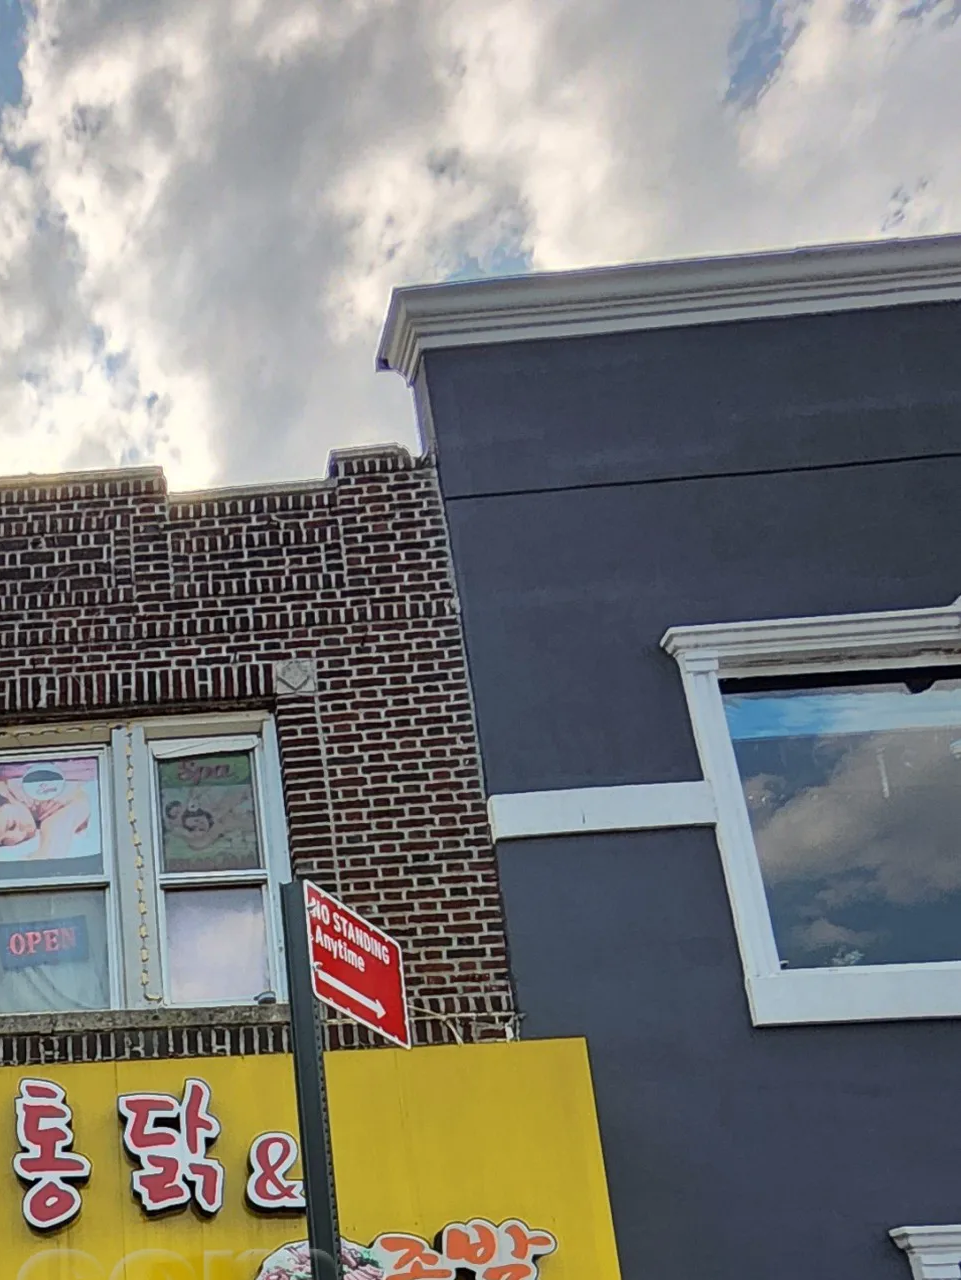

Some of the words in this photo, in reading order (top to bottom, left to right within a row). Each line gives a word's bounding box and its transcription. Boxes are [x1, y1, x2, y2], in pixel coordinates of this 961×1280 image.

[177, 760, 235, 785] Spa
[8, 927, 76, 957] OPEN
[310, 898, 330, 926] NO
[332, 912, 391, 965] STANDING
[315, 925, 366, 973] Anytime
